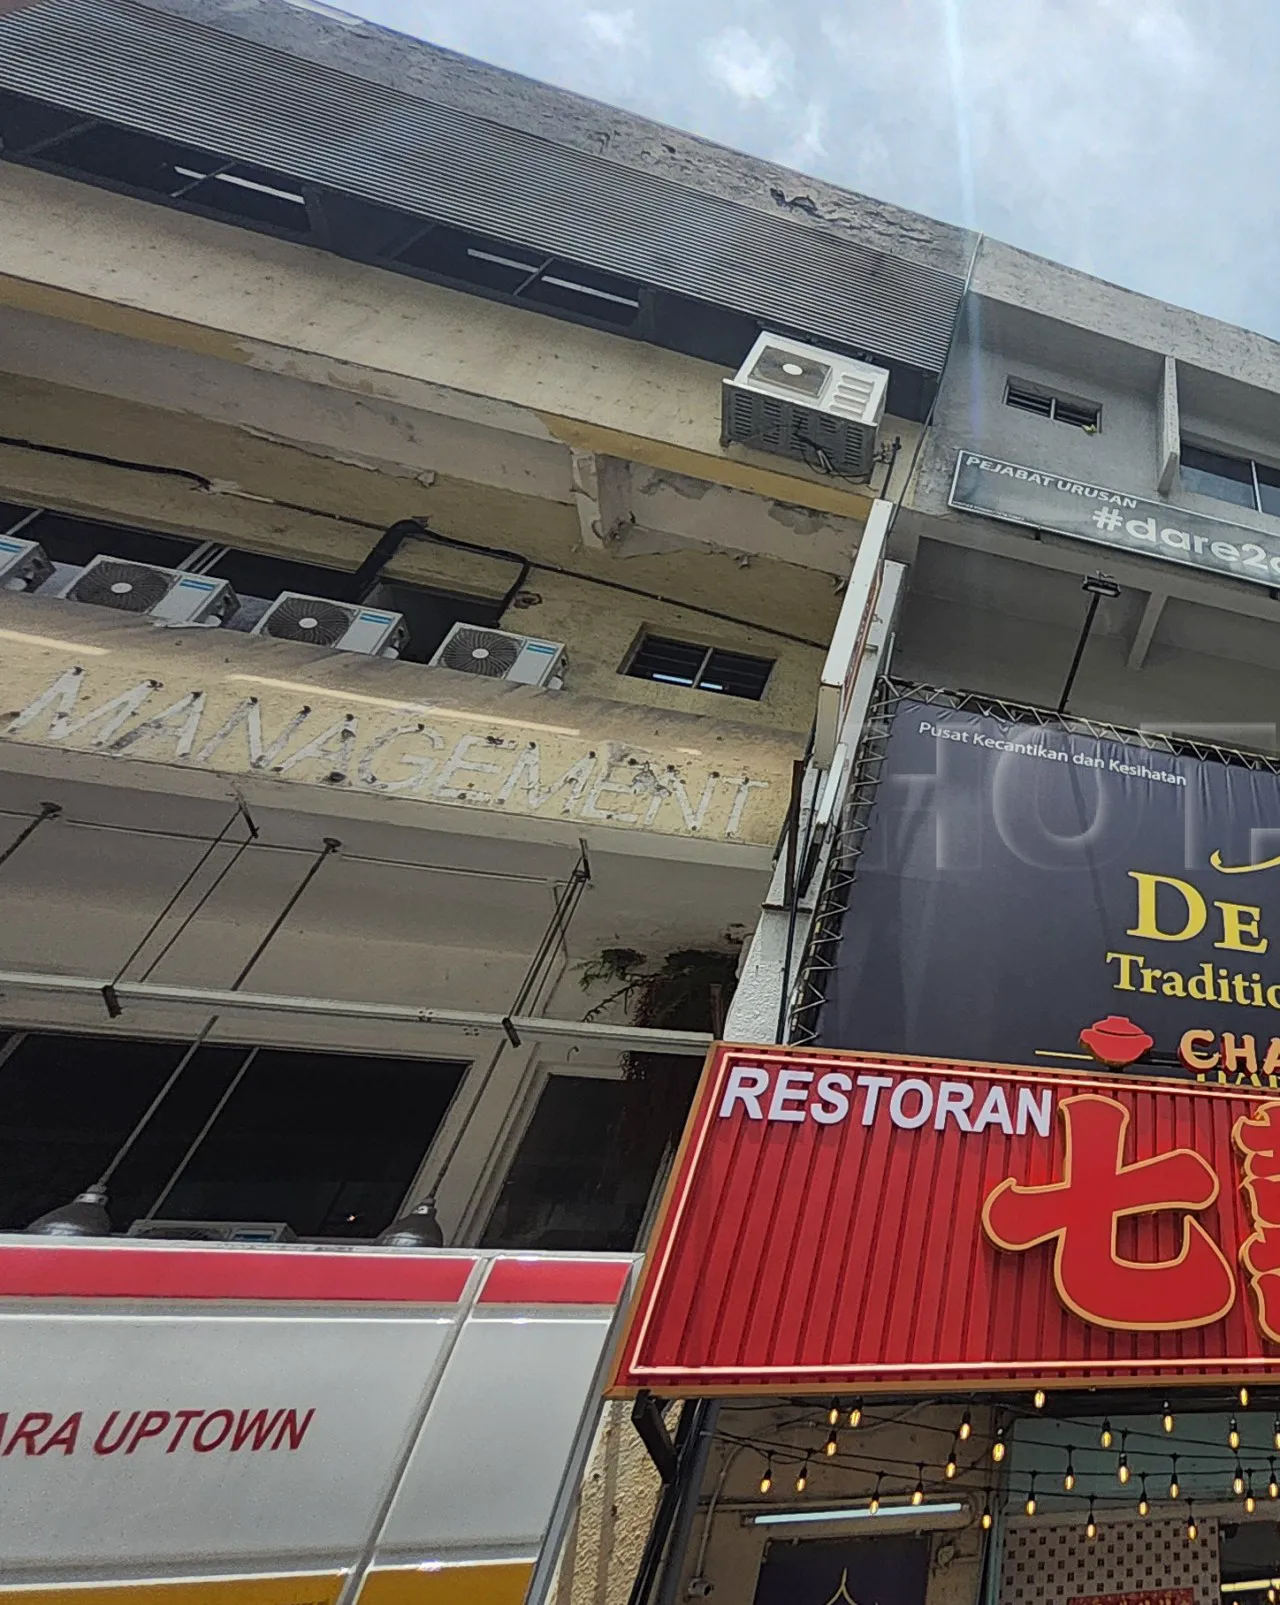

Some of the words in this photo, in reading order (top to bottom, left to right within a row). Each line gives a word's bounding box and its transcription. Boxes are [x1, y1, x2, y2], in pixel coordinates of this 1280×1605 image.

[965, 456, 1056, 486] PEJABAT
[1056, 479, 1137, 509] URUSAN
[4, 666, 771, 838] MANAGEMENT
[918, 721, 968, 744] Pusat
[972, 733, 1070, 763] Kecantikan
[1072, 752, 1105, 769] dan
[1108, 758, 1187, 786] Kesihatan
[718, 1066, 1052, 1138] RESTORAN
[0, 1411, 84, 1456] RA
[93, 1408, 317, 1456] UPTOWN
